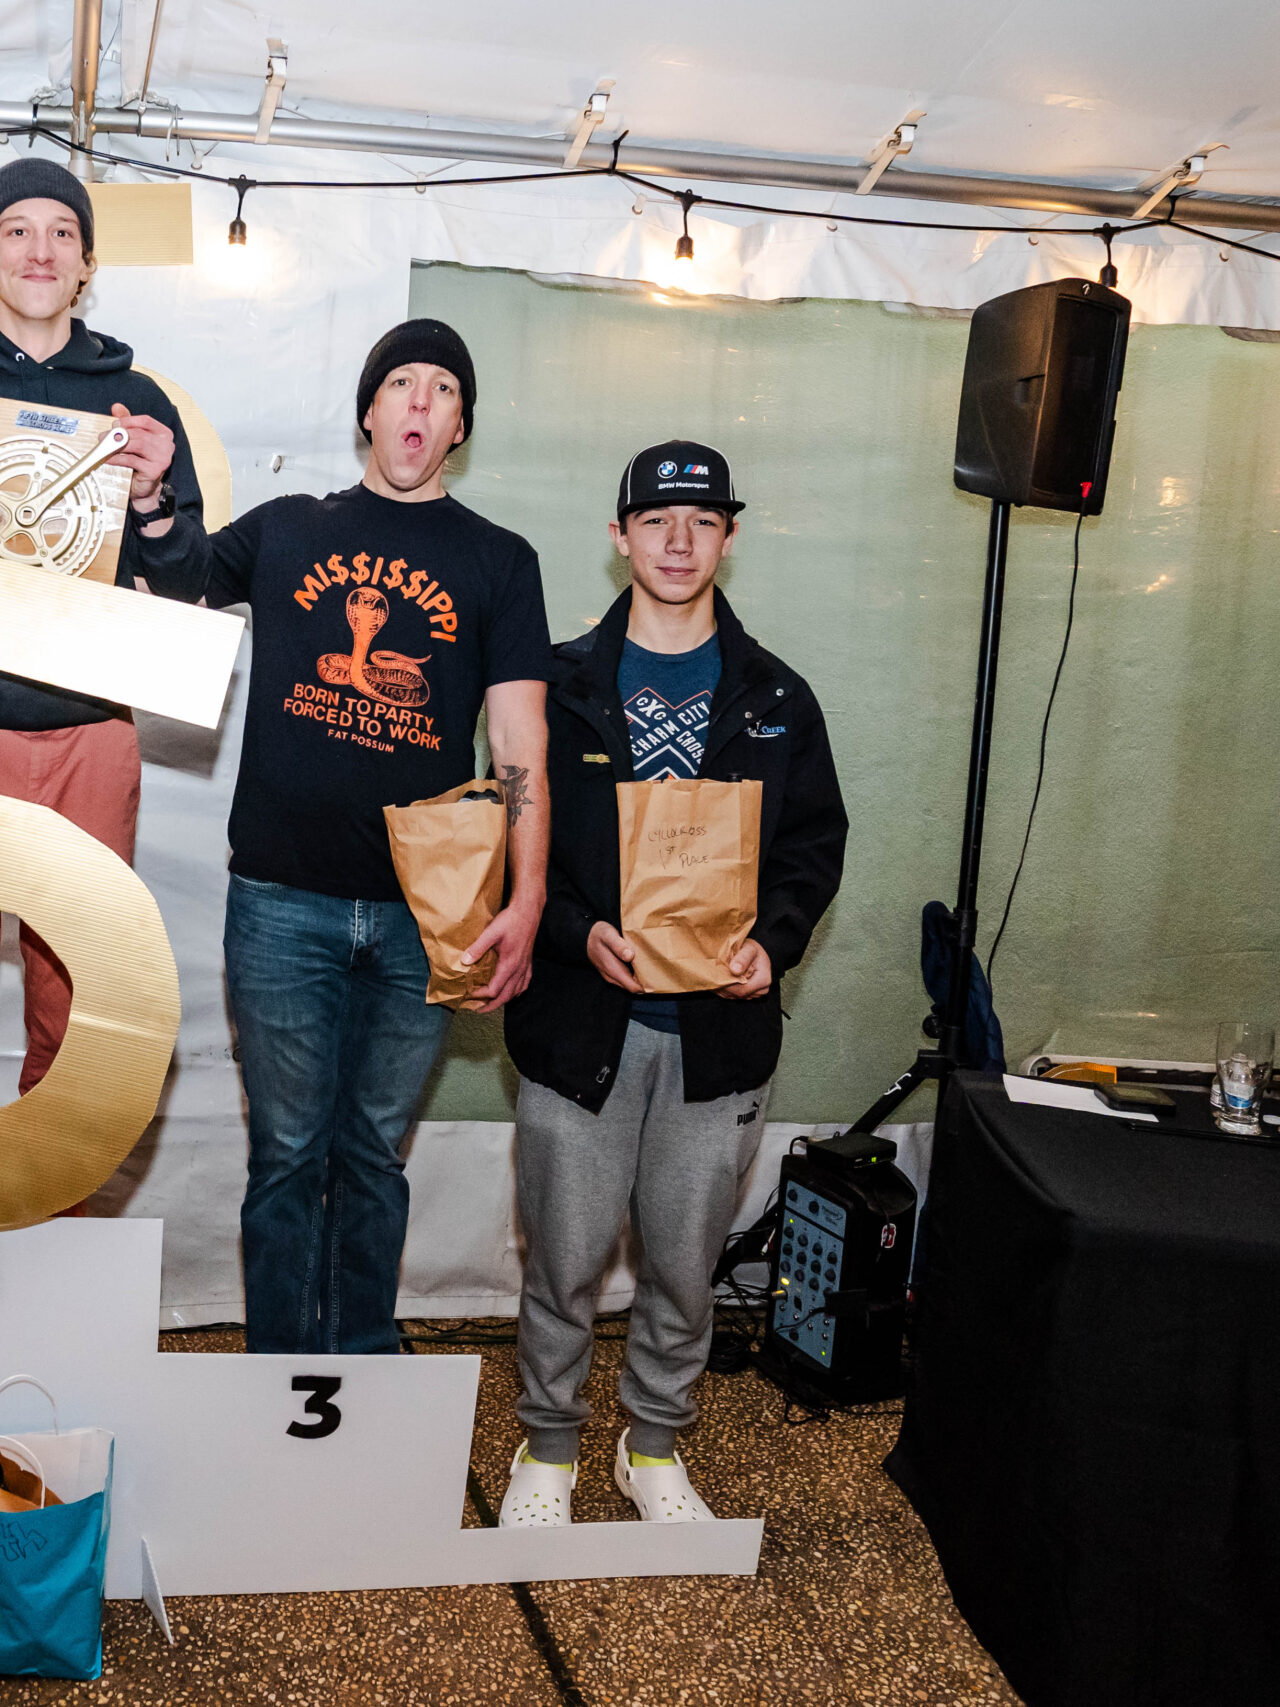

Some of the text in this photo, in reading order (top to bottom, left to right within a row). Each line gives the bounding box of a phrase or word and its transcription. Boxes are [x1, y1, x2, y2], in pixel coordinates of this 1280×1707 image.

[658, 482, 675, 490] BMW
[293, 551, 458, 643] MI$$I$$IPPI
[283, 698, 442, 751] FORCED TO WORK
[293, 683, 434, 732] BORN TO PARTY
[631, 701, 710, 757] CHARM CITY
[327, 729, 395, 753] FAT POSSUM
[285, 1376, 342, 1439] 3
